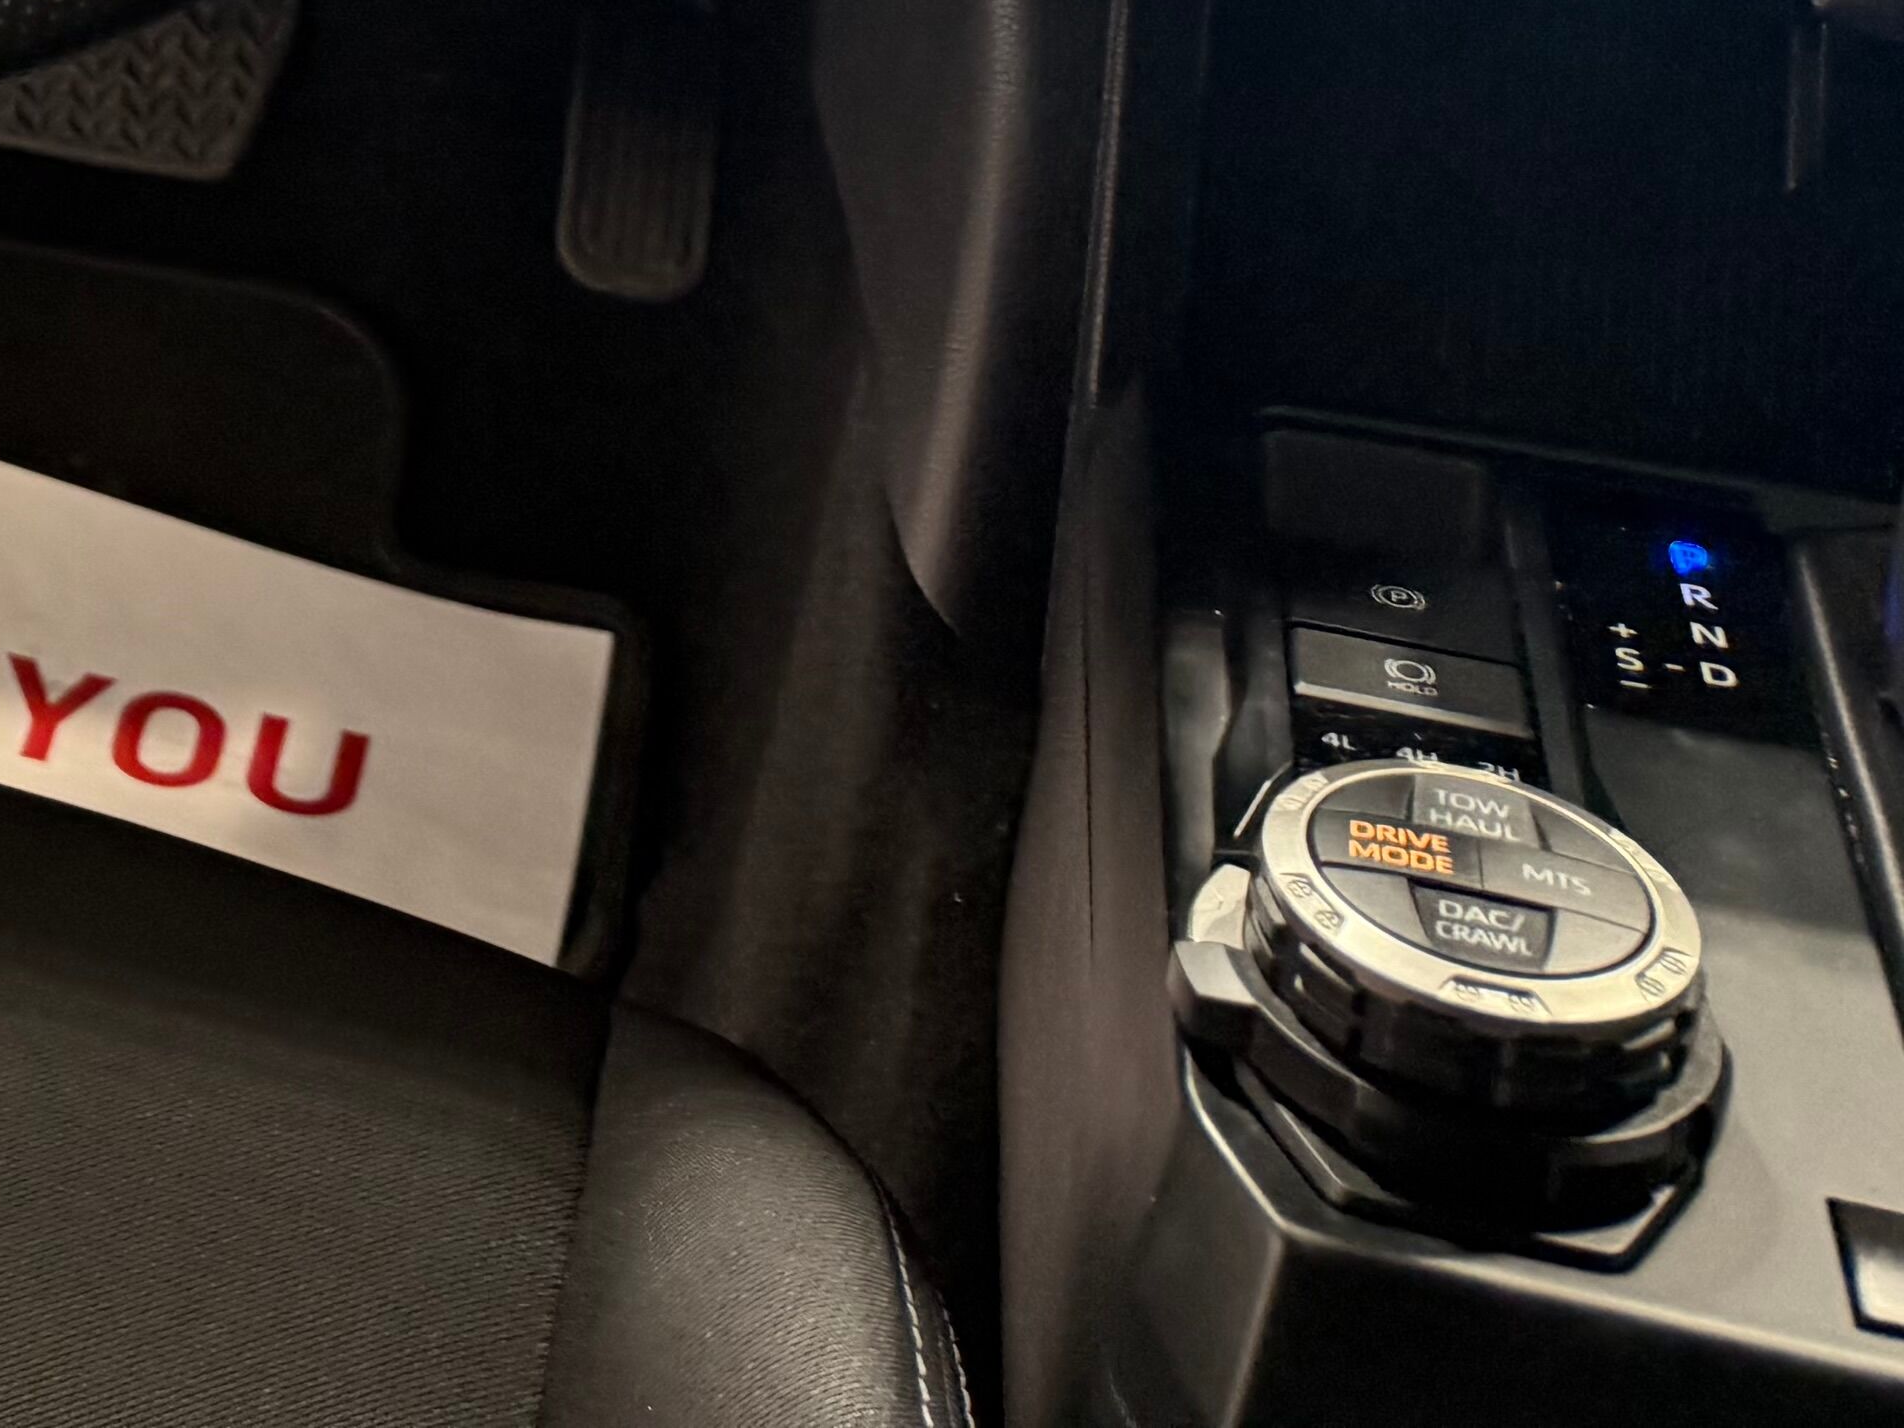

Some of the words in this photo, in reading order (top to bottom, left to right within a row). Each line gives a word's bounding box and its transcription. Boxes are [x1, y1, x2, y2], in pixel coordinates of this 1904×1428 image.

[1679, 582, 1719, 610] R
[1690, 621, 1729, 649] N
[1615, 647, 1645, 672] S
[1700, 660, 1740, 688] D
[1387, 680, 1438, 696] HOLD
[7, 651, 372, 820] YOU
[1321, 731, 1357, 751] 4L
[1434, 788, 1510, 818] TOW
[1349, 818, 1451, 855] DRIVE
[1428, 808, 1521, 842] HAUL
[1349, 838, 1455, 876] MODE
[1522, 862, 1592, 897] MTS
[1438, 898, 1527, 933] DAC/
[1435, 920, 1534, 959] CRAWL
